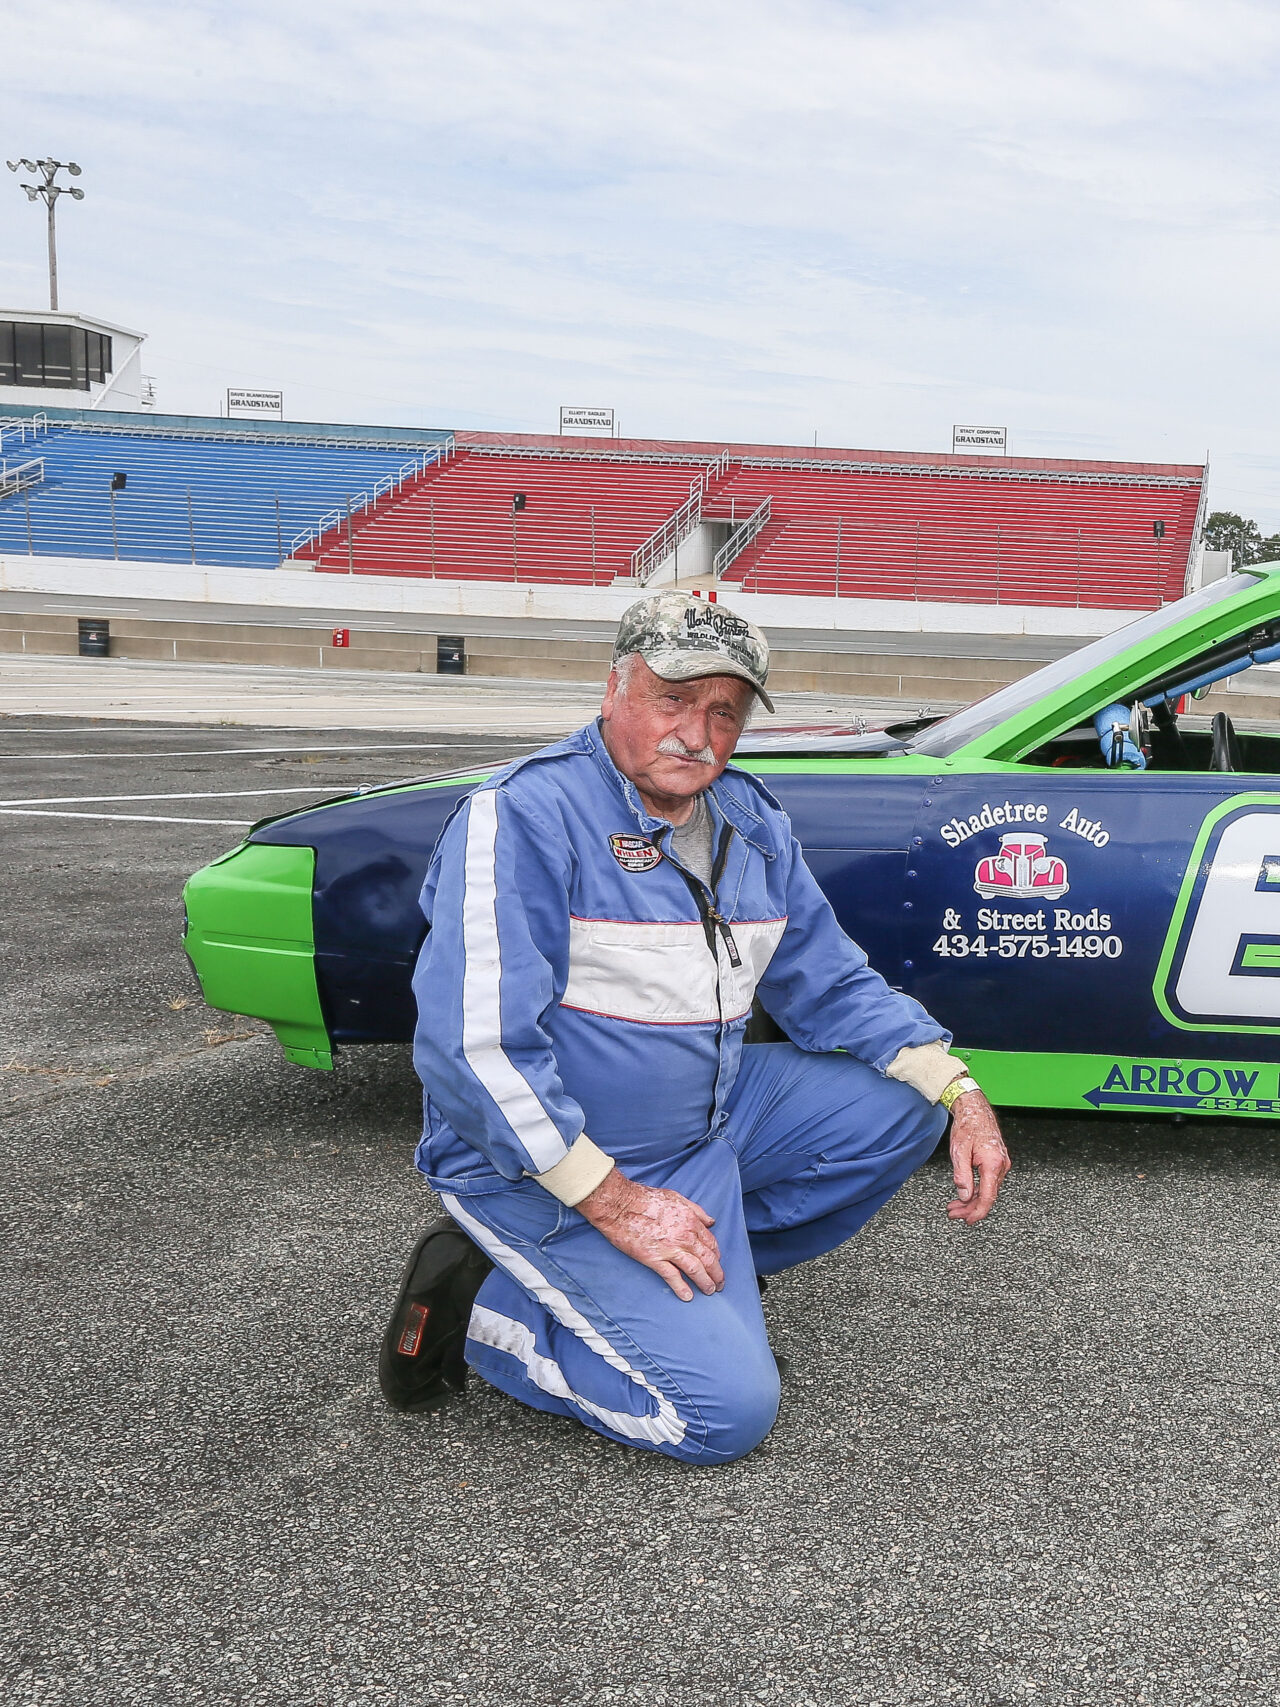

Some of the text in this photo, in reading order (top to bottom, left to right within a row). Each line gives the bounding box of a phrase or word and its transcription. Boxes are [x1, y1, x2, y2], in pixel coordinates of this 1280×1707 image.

[230, 399, 280, 409] GRANDSTAND
[562, 417, 612, 426] GRANDSTAND
[955, 435, 1004, 445] GRANDSTAND
[940, 800, 1111, 849] Shadetree Auto
[942, 908, 1112, 931] & Street Rods
[932, 934, 1123, 958] 434-575-1490
[1102, 1063, 1260, 1098] ARROW
